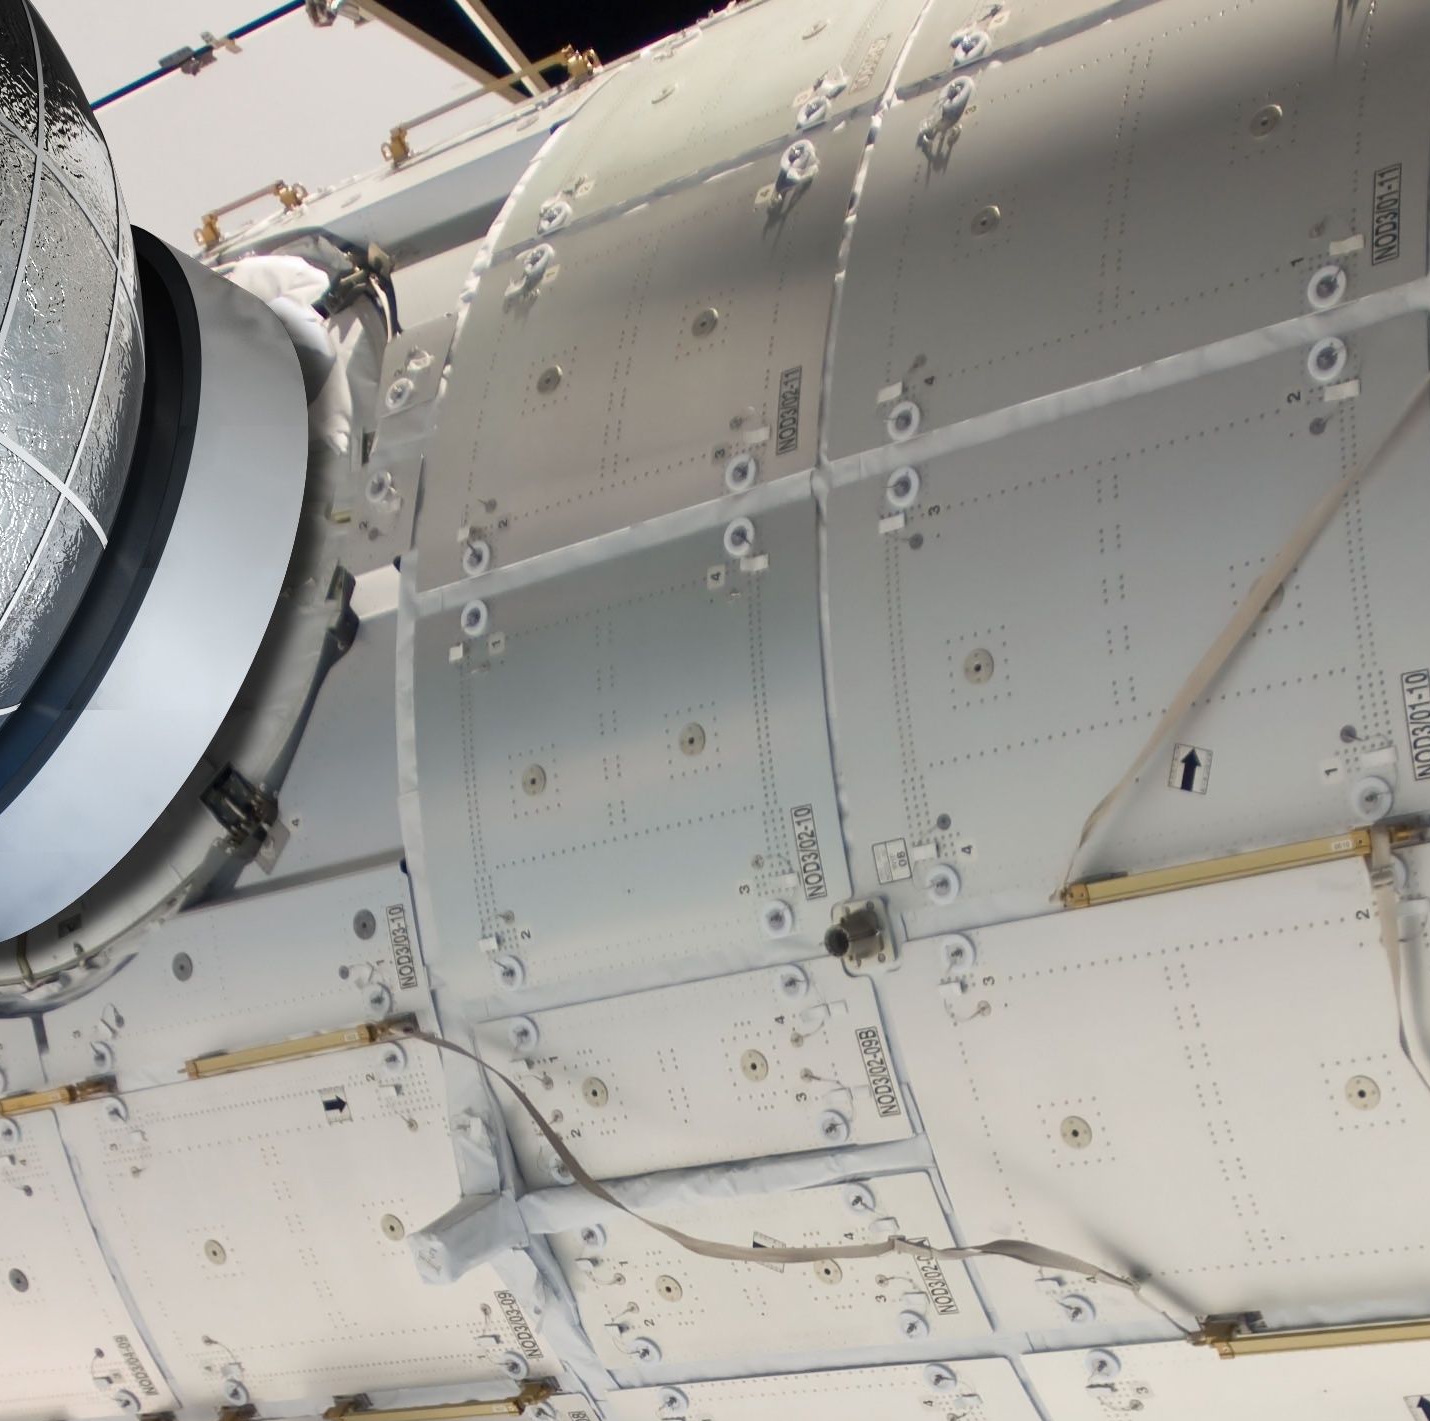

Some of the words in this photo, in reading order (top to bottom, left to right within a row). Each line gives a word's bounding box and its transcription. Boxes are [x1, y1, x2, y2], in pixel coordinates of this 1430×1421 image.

[1374, 165, 1400, 262] NOD3/01-11
[1290, 257, 1304, 267] 1
[924, 375, 935, 386] 4
[1286, 390, 1301, 405] 2
[778, 367, 800, 452] NOD3/02-11
[714, 448, 725, 459] 3
[928, 504, 941, 517] 3
[359, 521, 368, 530] 2
[498, 518, 508, 528] 2
[710, 572, 721, 581] 4
[491, 639, 501, 649] 1
[1324, 768, 1338, 776] 1
[794, 807, 823, 897] NOD3/02-10
[961, 845, 973, 855] 4
[739, 884, 750, 895] 3
[1355, 909, 1370, 921] 2
[521, 928, 531, 940] 2
[389, 906, 414, 987] NOD3/03-10
[982, 975, 995, 986] 3
[774, 1015, 785, 1024] 4
[548, 1055, 559, 1063] 1
[858, 1029, 897, 1114] NOD3/02-09B
[365, 1072, 375, 1082] 2
[796, 1092, 807, 1102] 3
[570, 1128, 581, 1138] 2
[843, 1232, 854, 1240] 4
[875, 1294, 887, 1303] 3
[496, 1291, 541, 1358] NOD3/03-09
[644, 1318, 655, 1327] 2
[115, 1335, 158, 1395] NOD3/04-09
